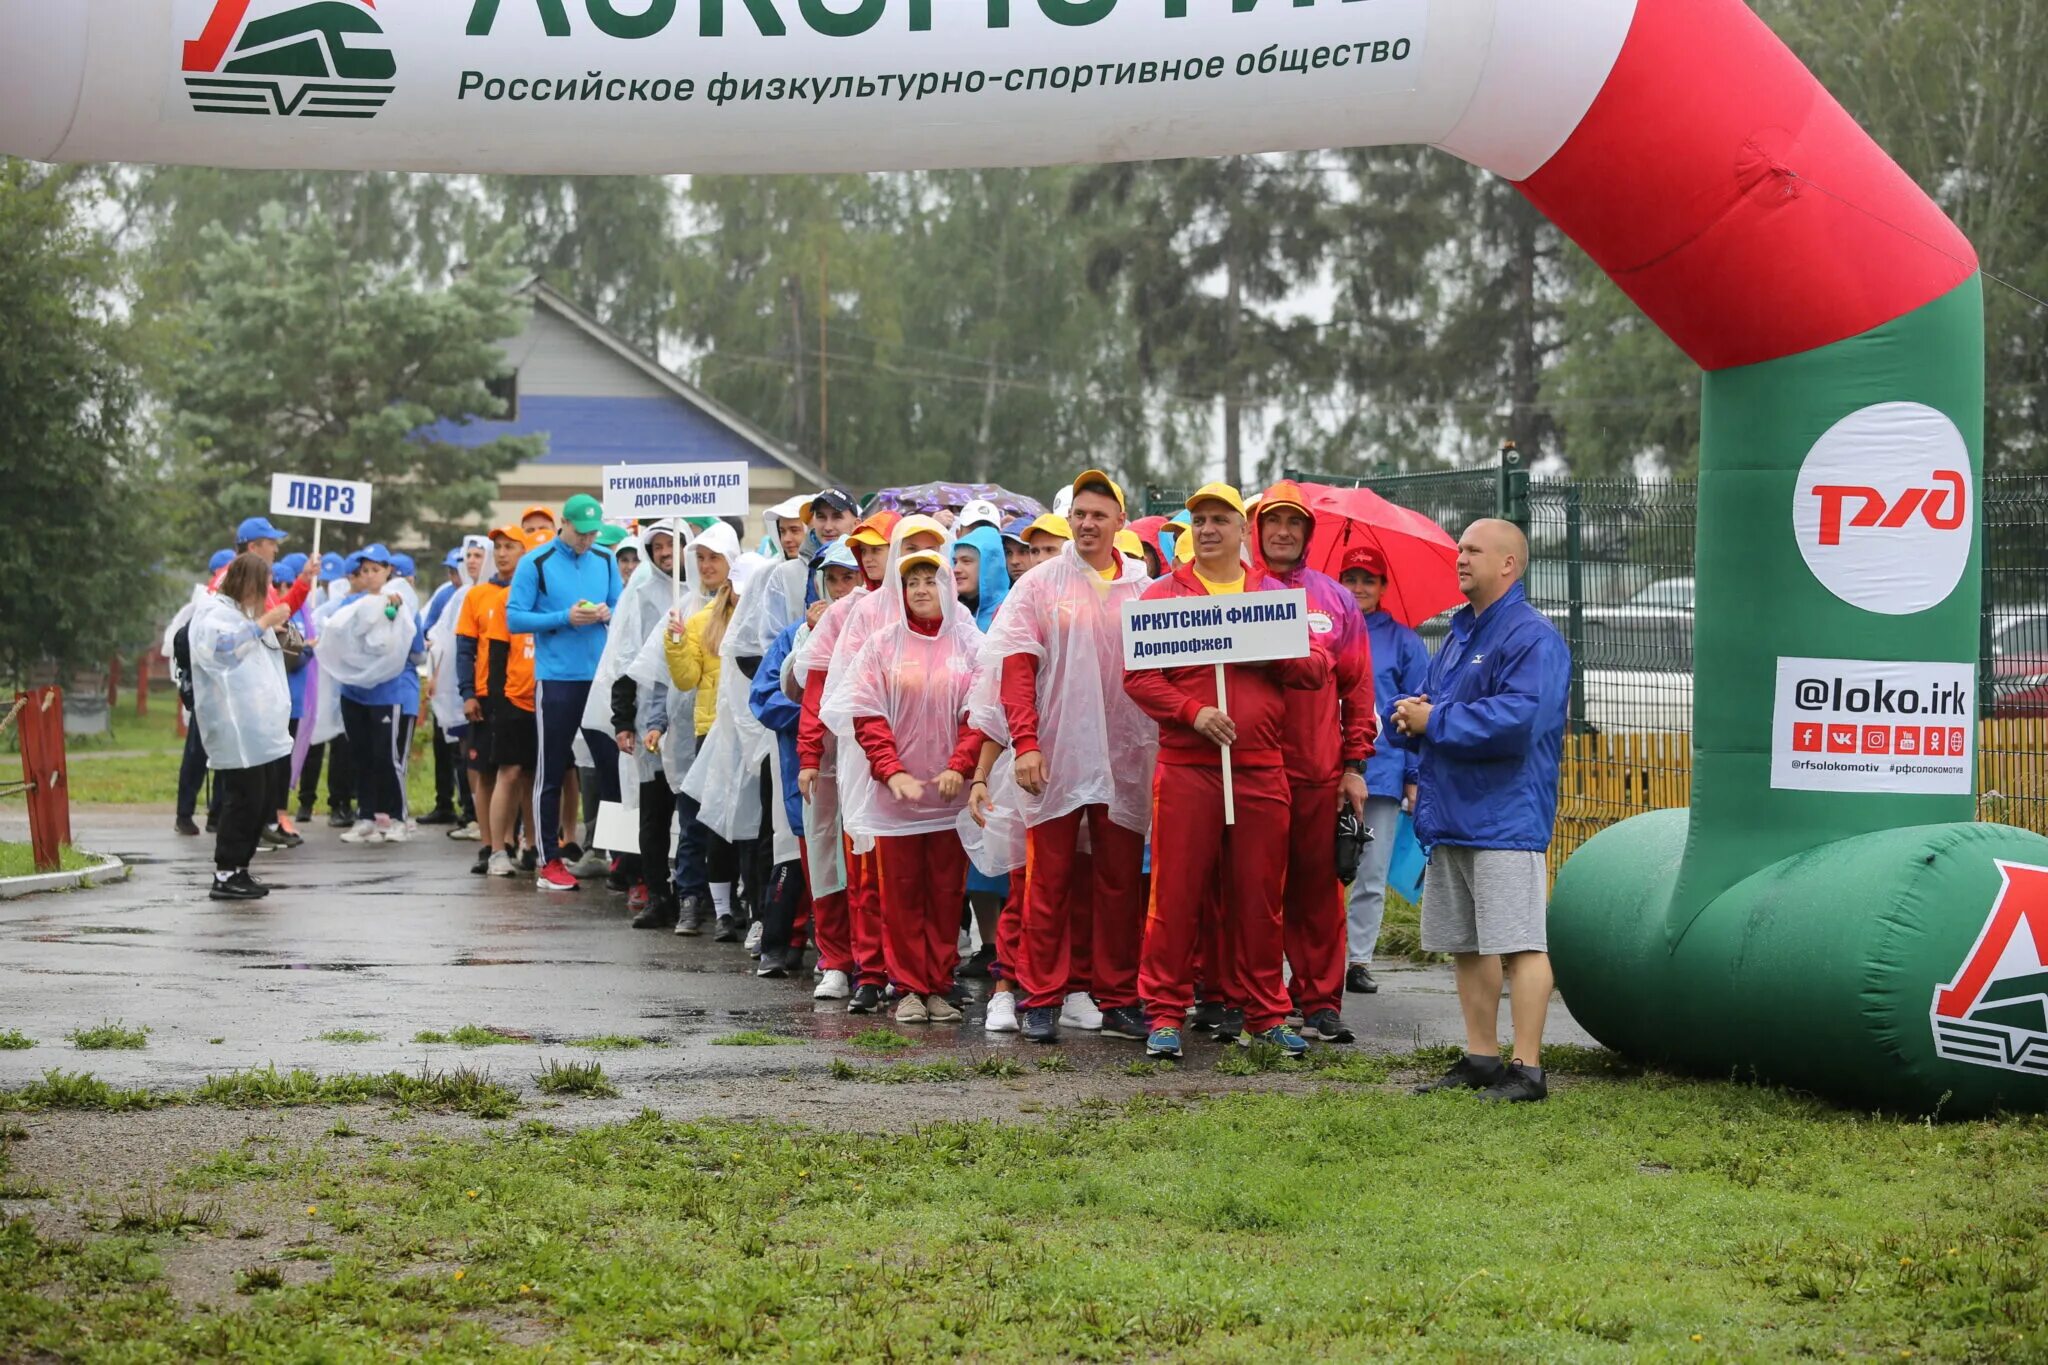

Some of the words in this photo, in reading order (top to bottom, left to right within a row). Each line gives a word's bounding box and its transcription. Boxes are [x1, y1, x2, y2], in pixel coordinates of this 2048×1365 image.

[458, 70, 695, 101] Российское
[706, 56, 1224, 105] физкультурно-спортивное
[1235, 37, 1411, 76] общество
[609, 473, 700, 490] РЕГИОНАЛЬНЫЙ
[703, 474, 740, 488] ОТДЕЛ
[287, 481, 355, 515] ЛВРЗ
[634, 492, 716, 508] ДОРПРОФЖЕЛ
[1131, 605, 1223, 632] ИРКУТСКИЙ
[1226, 602, 1297, 625] ФИЛИАЛ
[1133, 637, 1233, 658] Дорпрофжел
[1795, 678, 1965, 715] @loko.irk
[1791, 759, 1879, 773] @rfsolokomotiv
[1889, 763, 1963, 775] #рфсолокомотив
